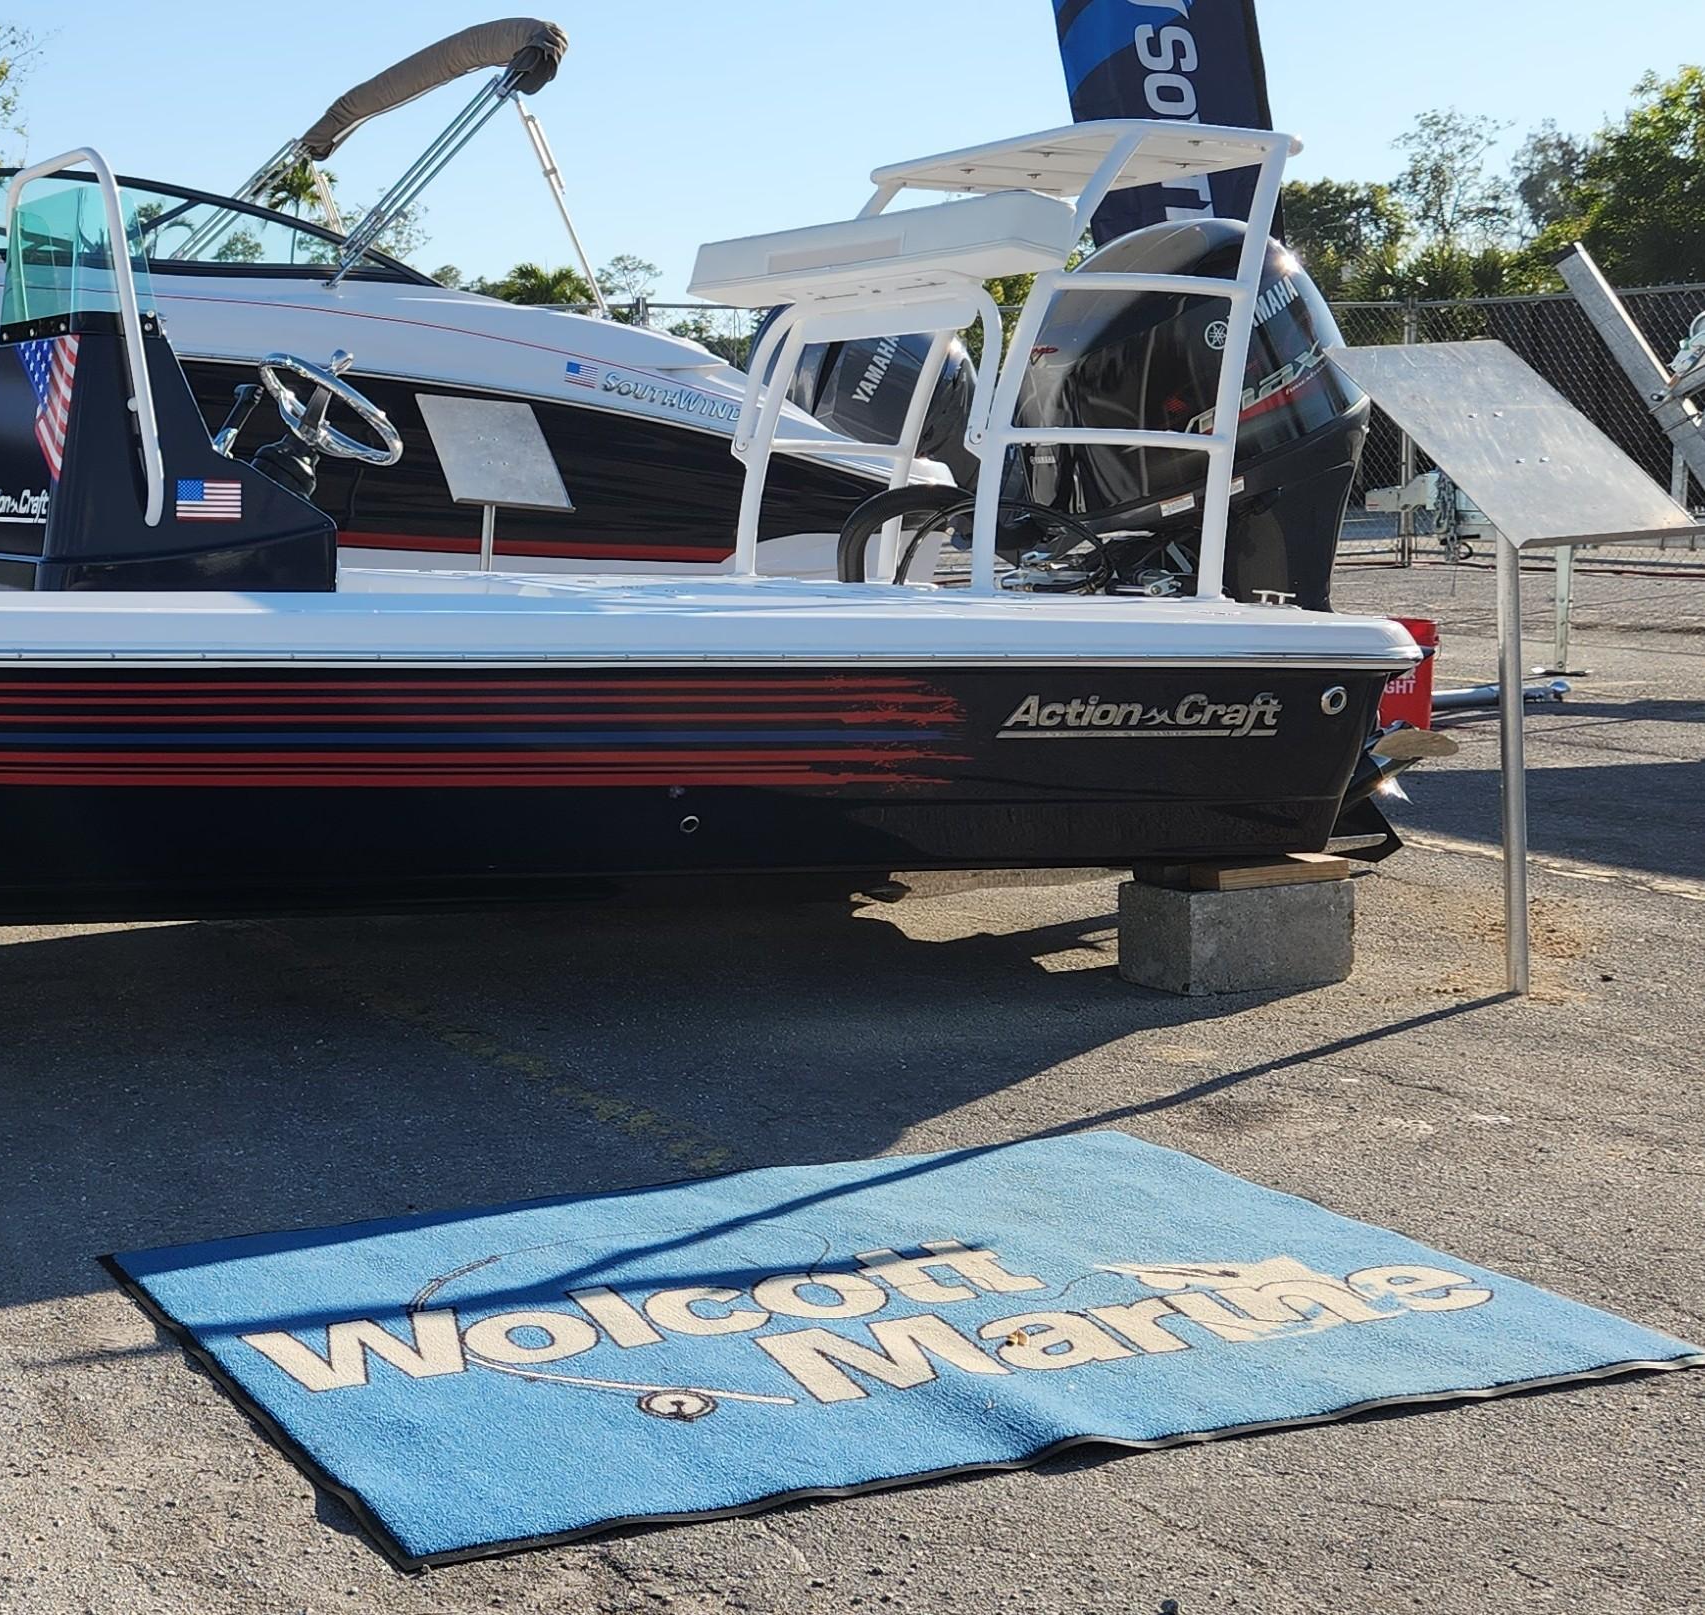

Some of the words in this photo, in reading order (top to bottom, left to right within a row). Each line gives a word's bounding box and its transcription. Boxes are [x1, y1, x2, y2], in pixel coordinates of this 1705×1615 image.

[18, 489, 50, 523] Craft
[1002, 695, 1144, 727] Action
[1174, 692, 1283, 737] Craft
[240, 1238, 1046, 1392] Wolcott
[756, 1258, 1494, 1403] Marine
